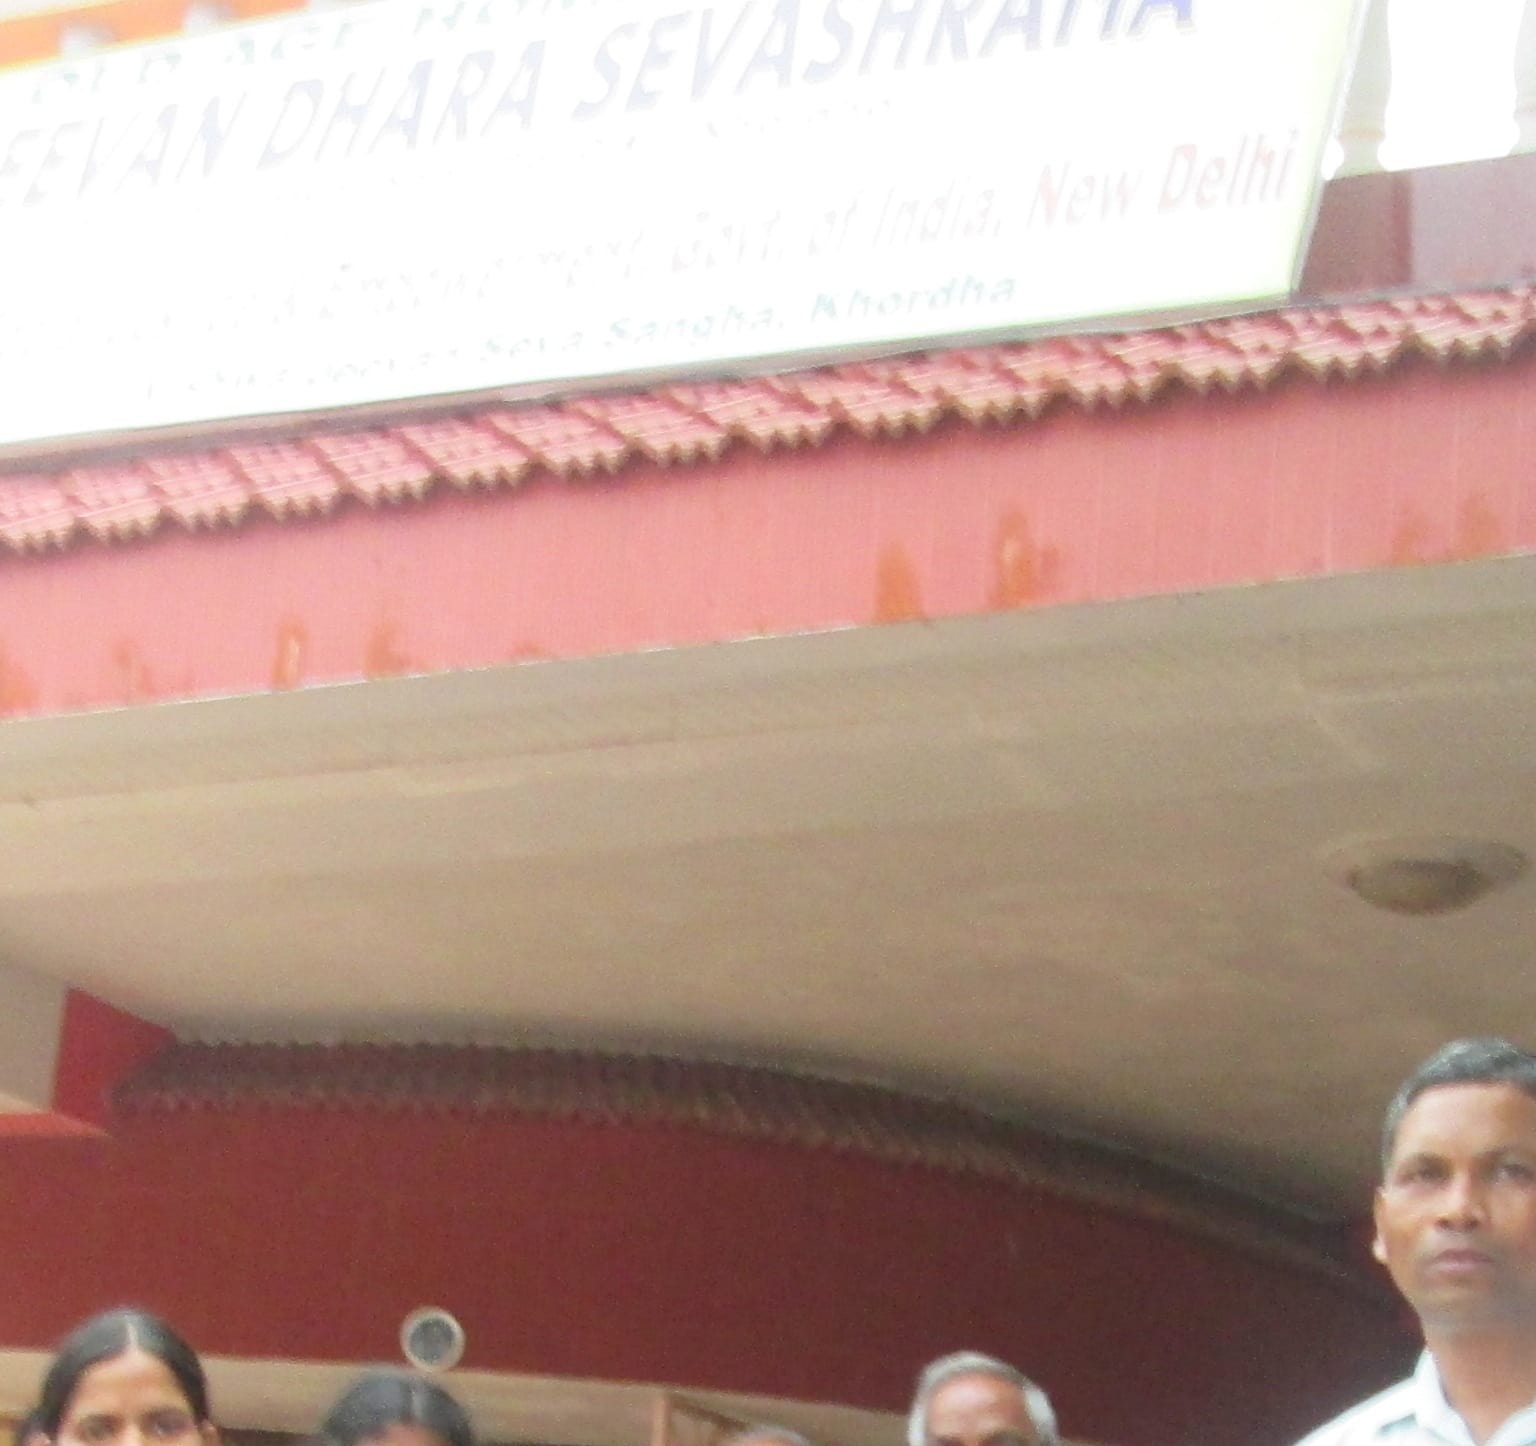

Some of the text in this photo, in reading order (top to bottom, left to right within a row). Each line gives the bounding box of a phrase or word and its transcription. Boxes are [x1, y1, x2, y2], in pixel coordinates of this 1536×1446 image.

[254, 39, 548, 171] DHARA
[1024, 158, 1146, 234] New
[1154, 124, 1302, 218] Delhi
[806, 271, 1020, 326] Khordha
